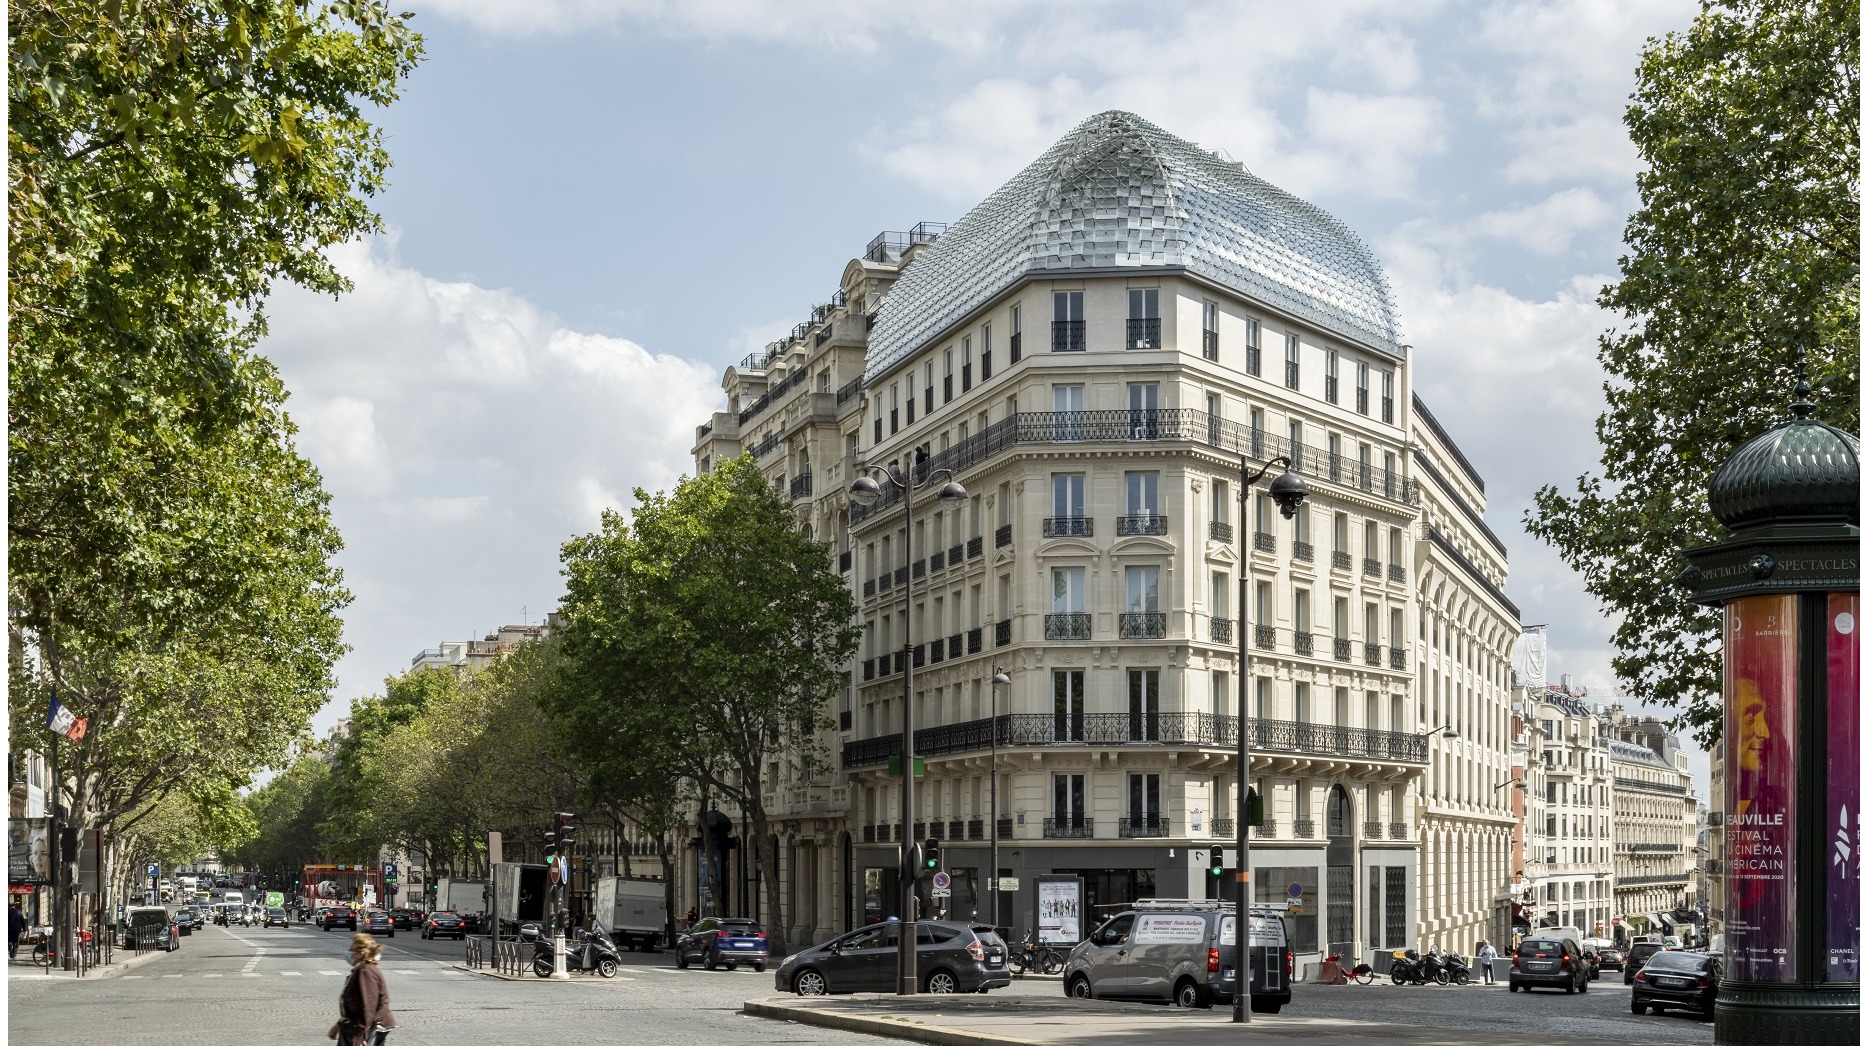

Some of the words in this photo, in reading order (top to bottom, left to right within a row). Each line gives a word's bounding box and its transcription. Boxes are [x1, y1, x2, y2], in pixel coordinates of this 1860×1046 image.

[1777, 559, 1856, 571] SPECTACLES
[1701, 563, 1748, 580] SPECTACLES
[1726, 830, 1769, 841] ESTIVAL
[1735, 842, 1783, 855] CINÉMA
[386, 866, 392, 874] P
